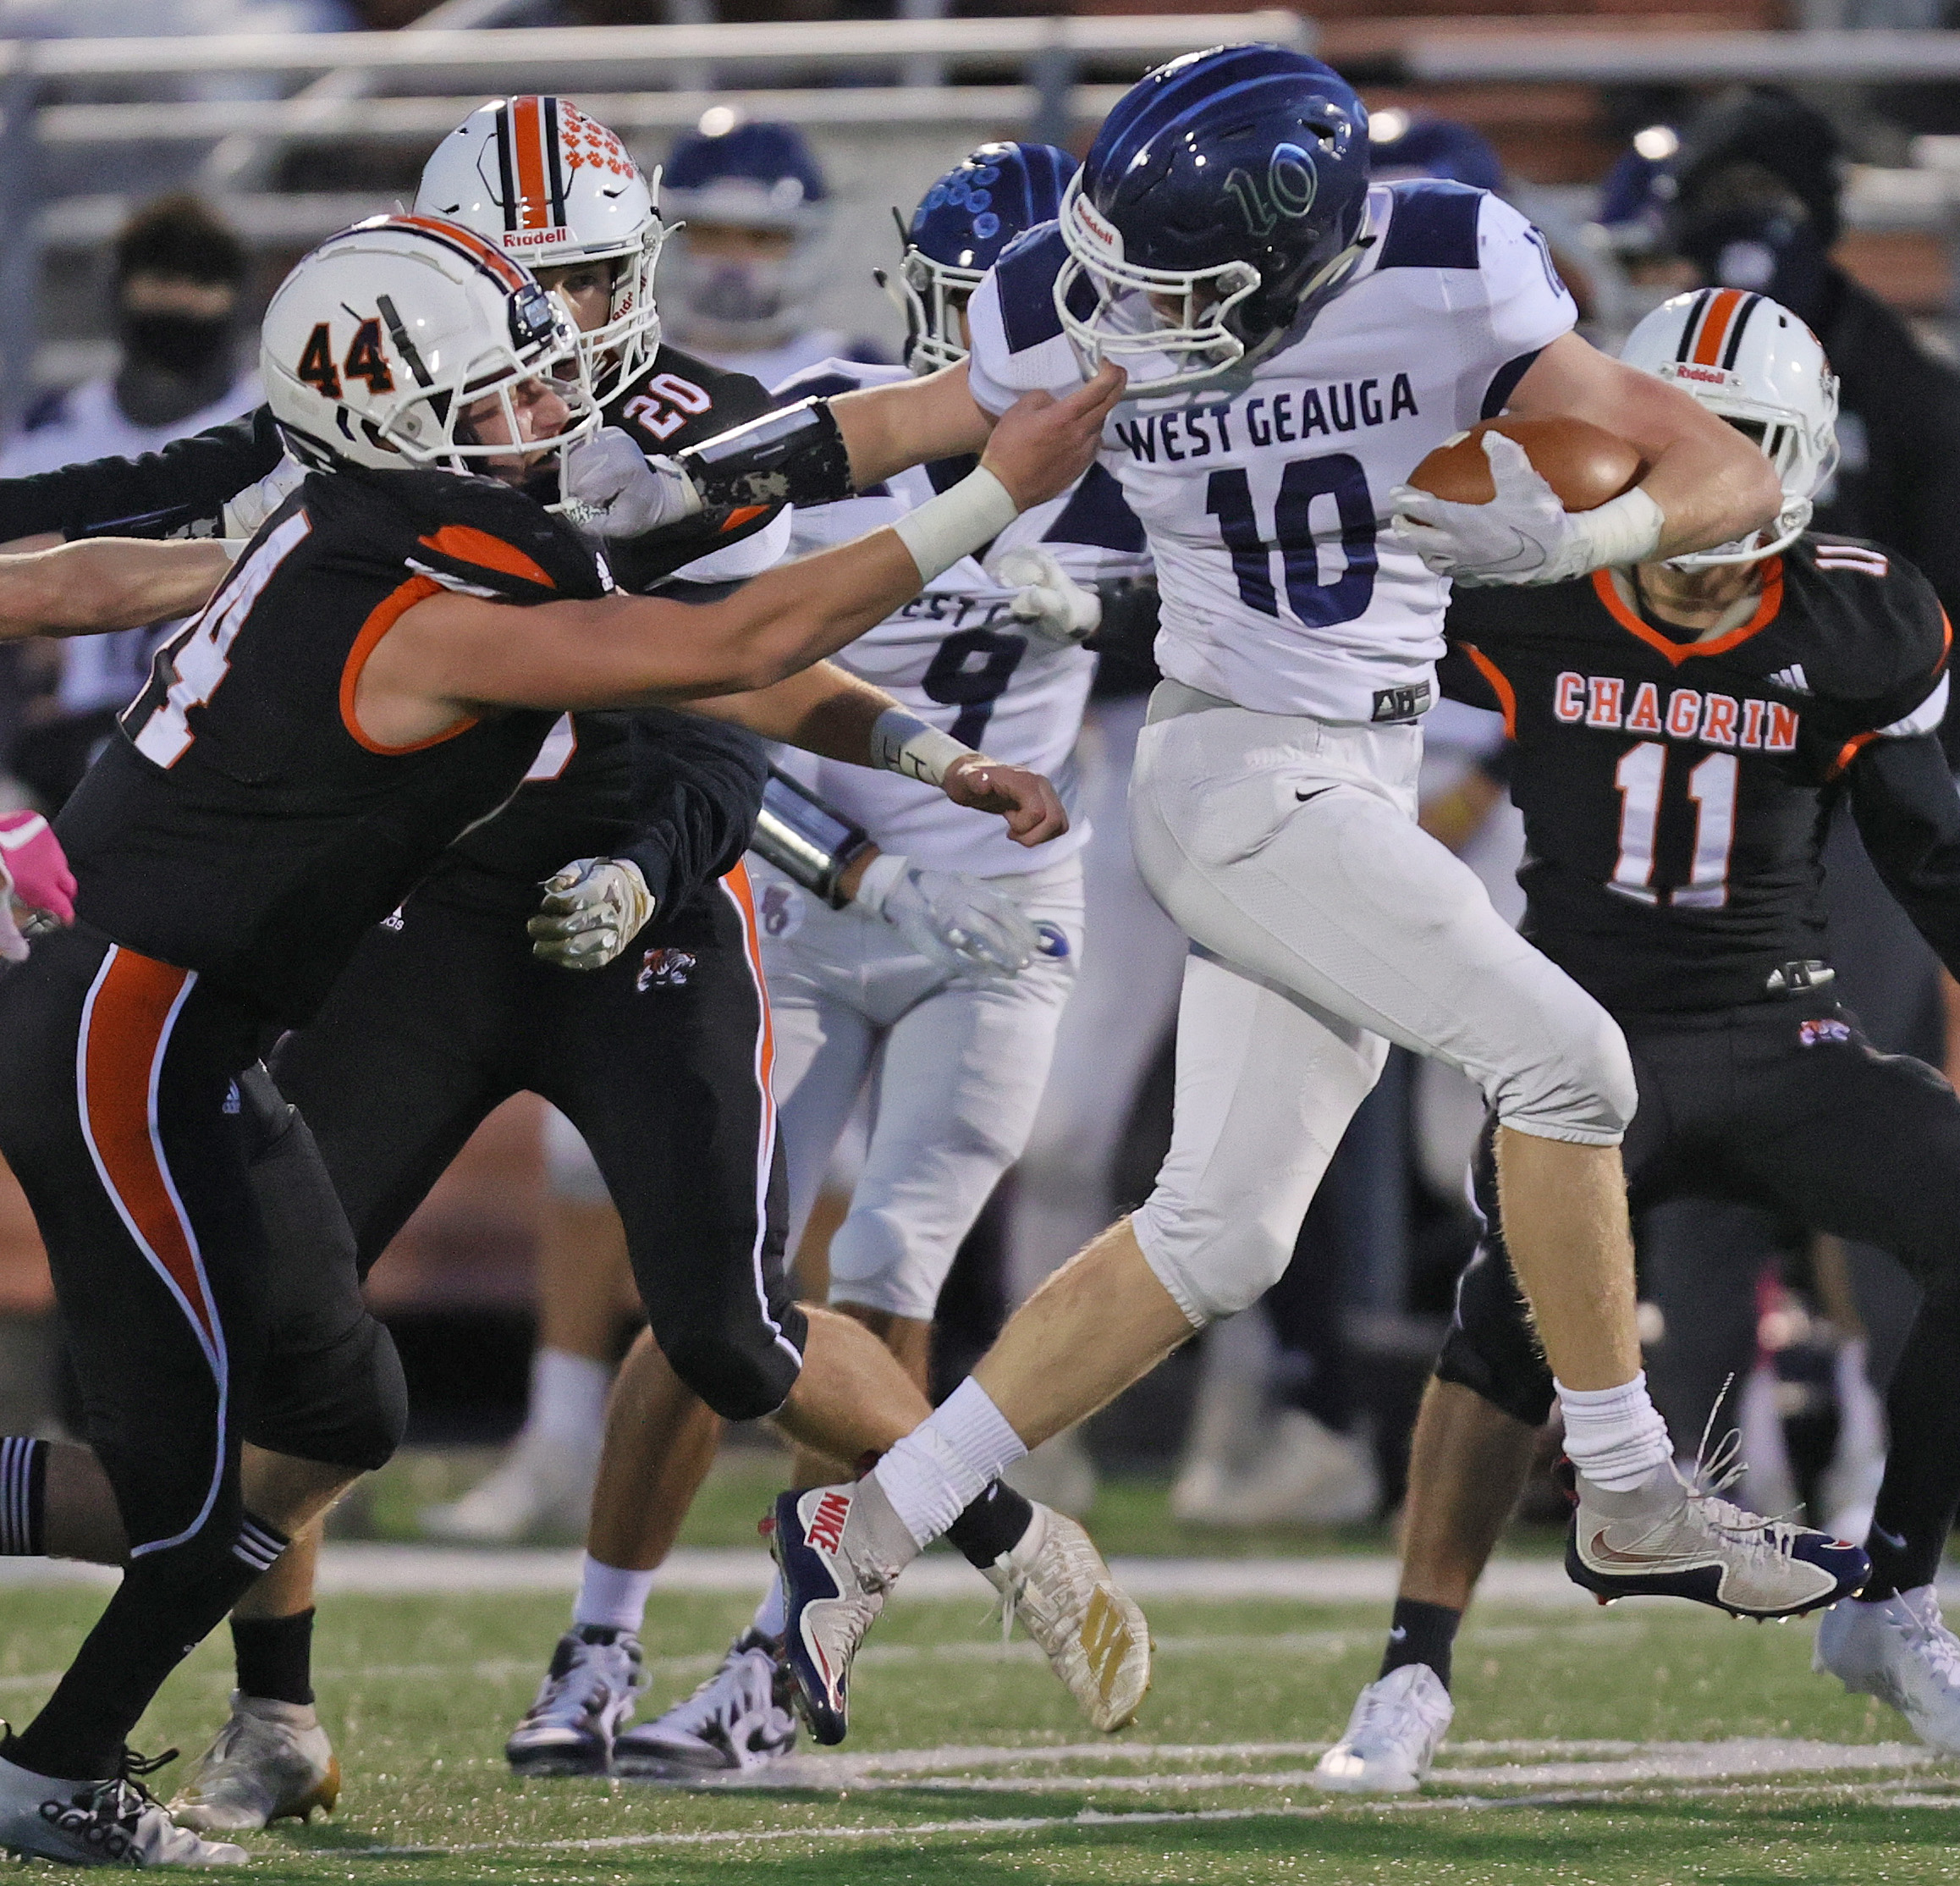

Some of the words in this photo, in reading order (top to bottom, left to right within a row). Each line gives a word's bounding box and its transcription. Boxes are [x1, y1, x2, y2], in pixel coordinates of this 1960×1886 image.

[1224, 142, 1318, 236] 10
[504, 228, 567, 247] Riddell
[298, 317, 395, 400] 44
[1676, 365, 1726, 384] Riddell
[623, 372, 713, 440] 20
[1115, 403, 1231, 462] WEST
[1247, 373, 1418, 446] GEAUGA
[1206, 453, 1379, 627] 10
[921, 626, 1028, 752] 9
[1554, 671, 1800, 751] CHAGRIN
[1606, 741, 1740, 907] 11
[807, 1492, 851, 1555] NIKE
